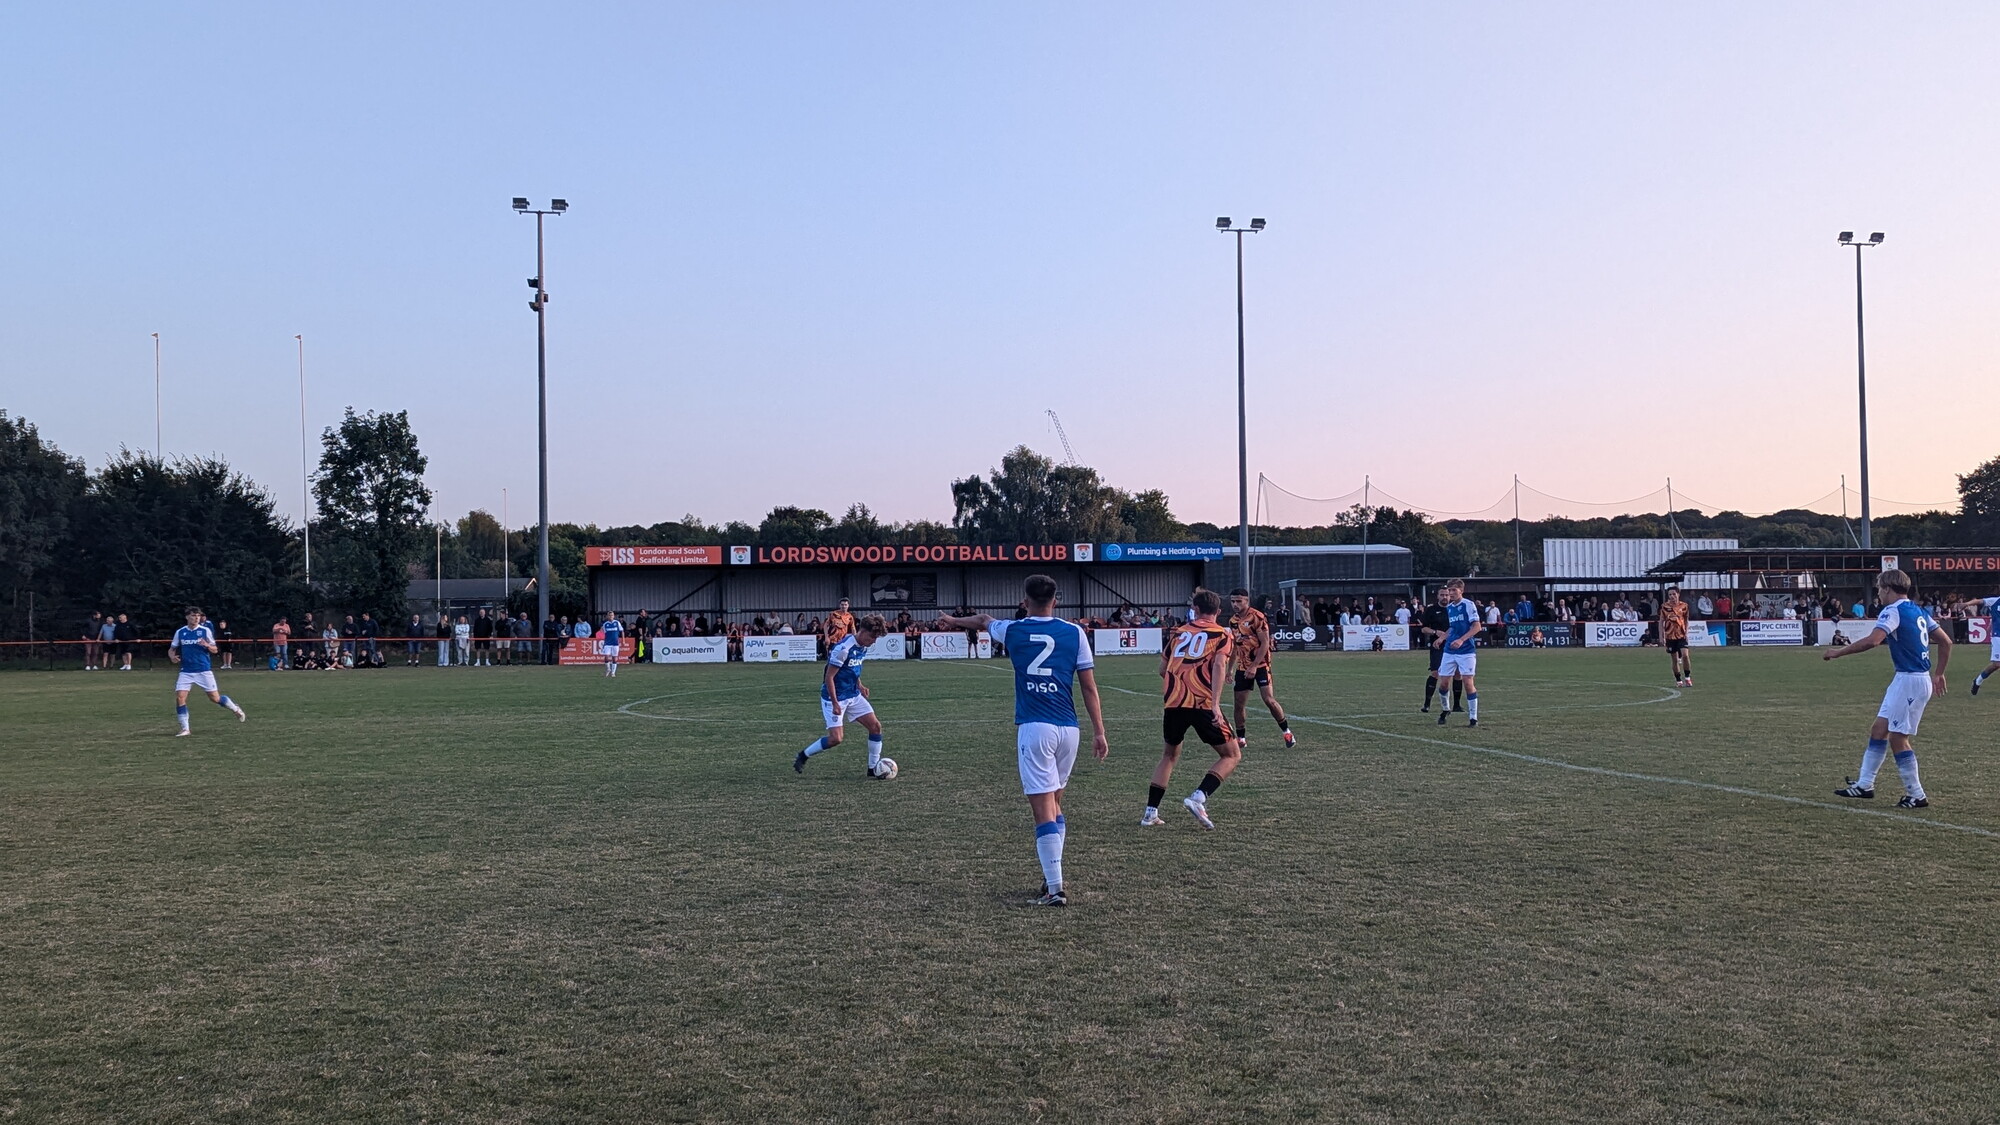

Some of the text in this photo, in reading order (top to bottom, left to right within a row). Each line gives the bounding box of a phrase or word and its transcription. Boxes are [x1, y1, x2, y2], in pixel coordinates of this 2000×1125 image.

[612, 548, 634, 564] LSS
[758, 544, 1067, 563] LORDSWOOD FOOTBALL CLUB
[1128, 548, 1160, 556] Plumbing
[1168, 547, 1196, 556] Heating
[640, 556, 680, 564] Scaffolding
[1912, 558, 1942, 570] THE
[1945, 558, 1983, 570] DAVE
[1274, 629, 1302, 640] dice
[1916, 616, 1930, 648] 8
[923, 634, 956, 648] KCR
[1174, 631, 1208, 658] 20
[1556, 636, 1570, 645] 131
[672, 647, 714, 655] aquatherm
[1026, 634, 1056, 676] 2
[1026, 682, 1058, 693] PISO
